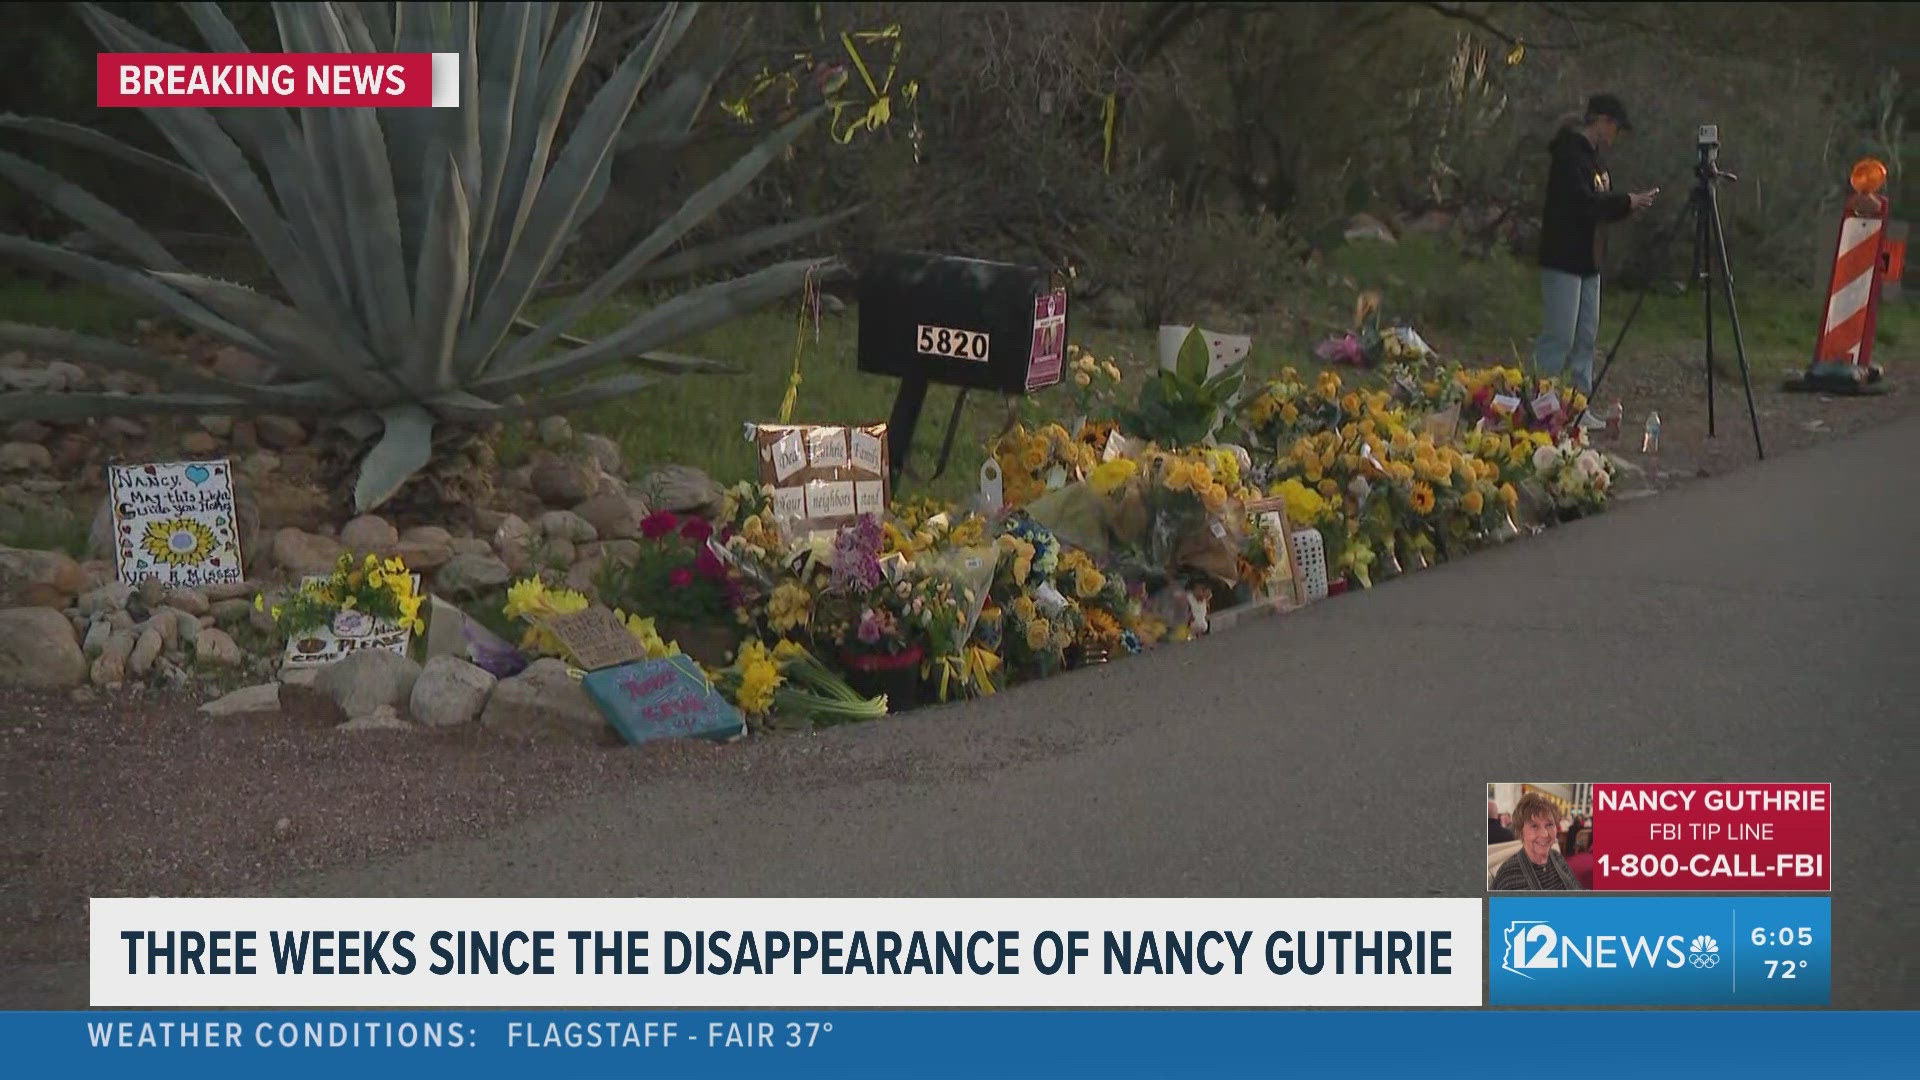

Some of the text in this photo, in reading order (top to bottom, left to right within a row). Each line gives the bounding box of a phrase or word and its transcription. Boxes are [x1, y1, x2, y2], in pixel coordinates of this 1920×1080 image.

[919, 326, 988, 359] 5820
[812, 489, 851, 513] neighbors
[860, 488, 880, 506] stand
